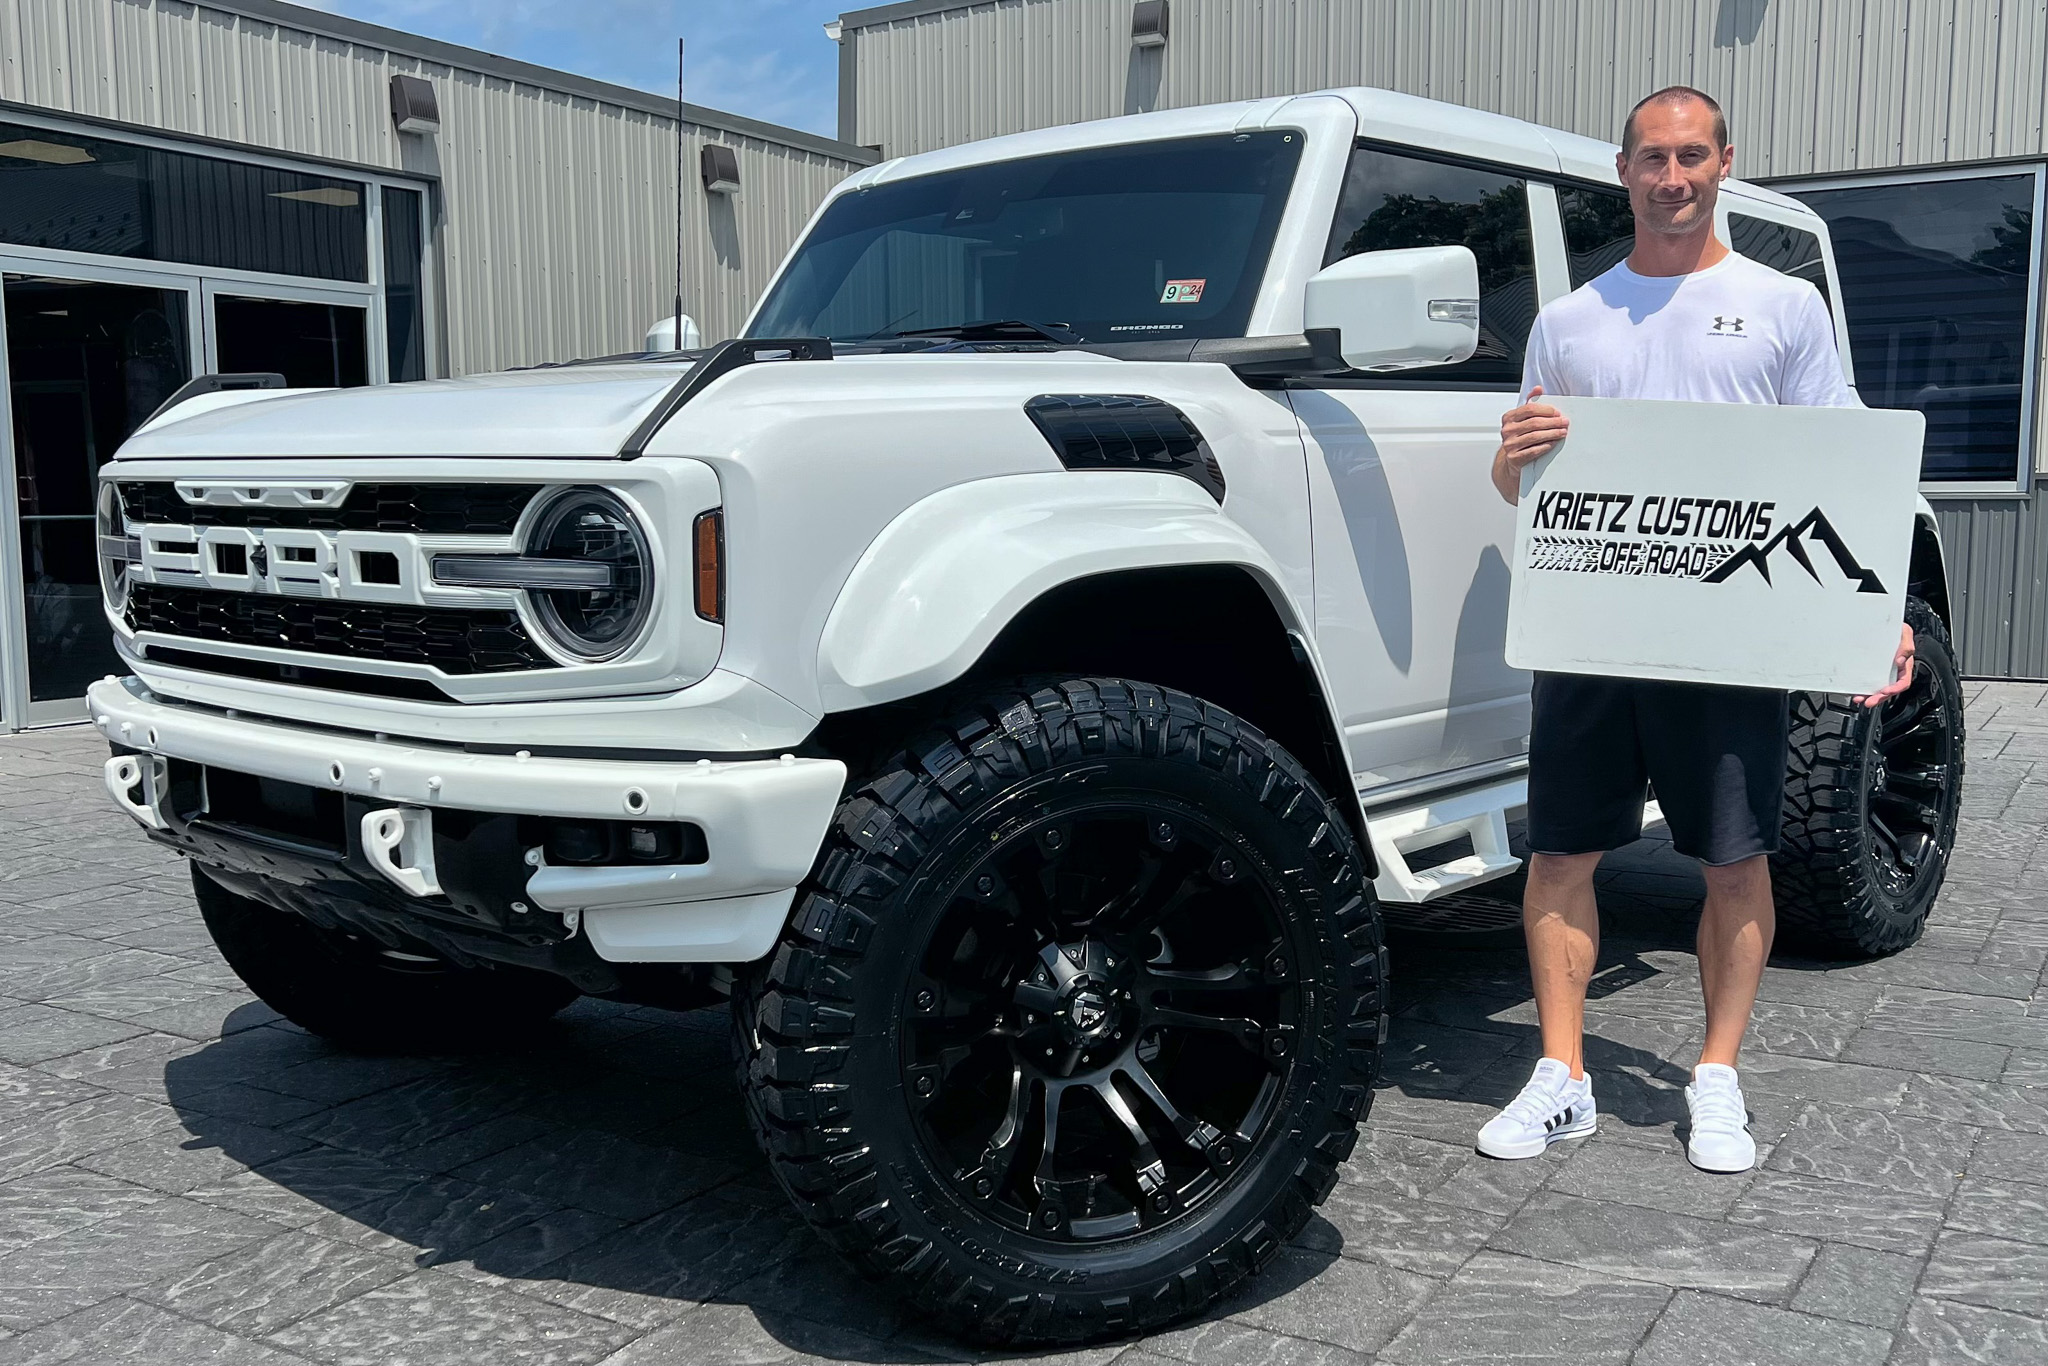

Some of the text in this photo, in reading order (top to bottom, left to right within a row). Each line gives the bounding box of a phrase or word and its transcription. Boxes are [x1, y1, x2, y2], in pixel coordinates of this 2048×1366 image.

[1166, 285, 1202, 299] 9 24
[1532, 490, 1776, 541] KRIETZ CUSTOMS
[140, 523, 425, 605] FORD
[1599, 541, 1707, 577] OFF ROAD
